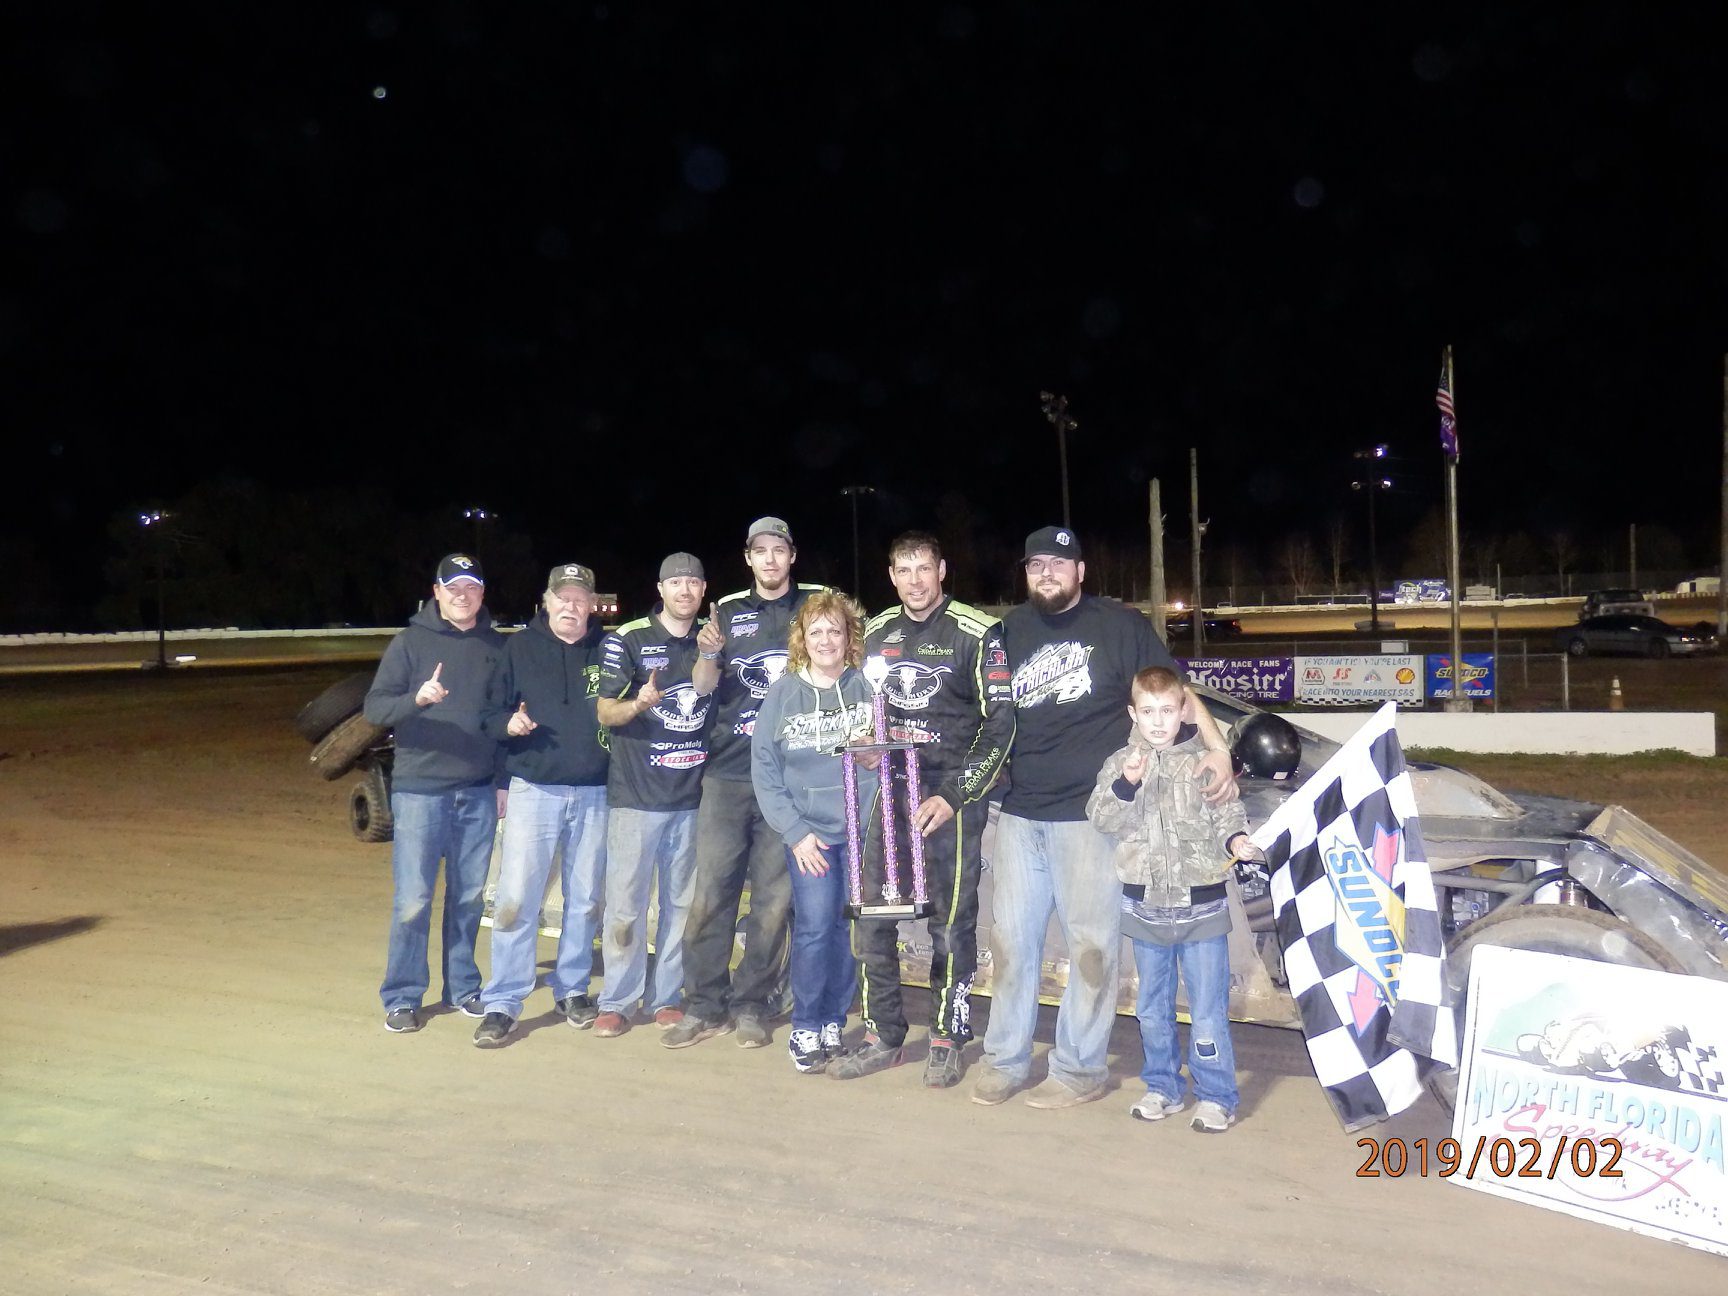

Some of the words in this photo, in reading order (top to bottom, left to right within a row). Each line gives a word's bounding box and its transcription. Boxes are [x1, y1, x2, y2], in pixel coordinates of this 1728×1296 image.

[1187, 660, 1225, 669] WELCOME
[1231, 660, 1253, 668] RACE
[1259, 659, 1281, 668] FANS
[1391, 657, 1412, 666] LAST
[1186, 667, 1287, 692] Hoosier
[1258, 691, 1280, 699] TIRE
[1341, 688, 1362, 697] YOUR
[1362, 688, 1396, 697] NEAREST
[1471, 1066, 1580, 1126] NORTH
[1587, 1086, 1726, 1175] FLORIDA
